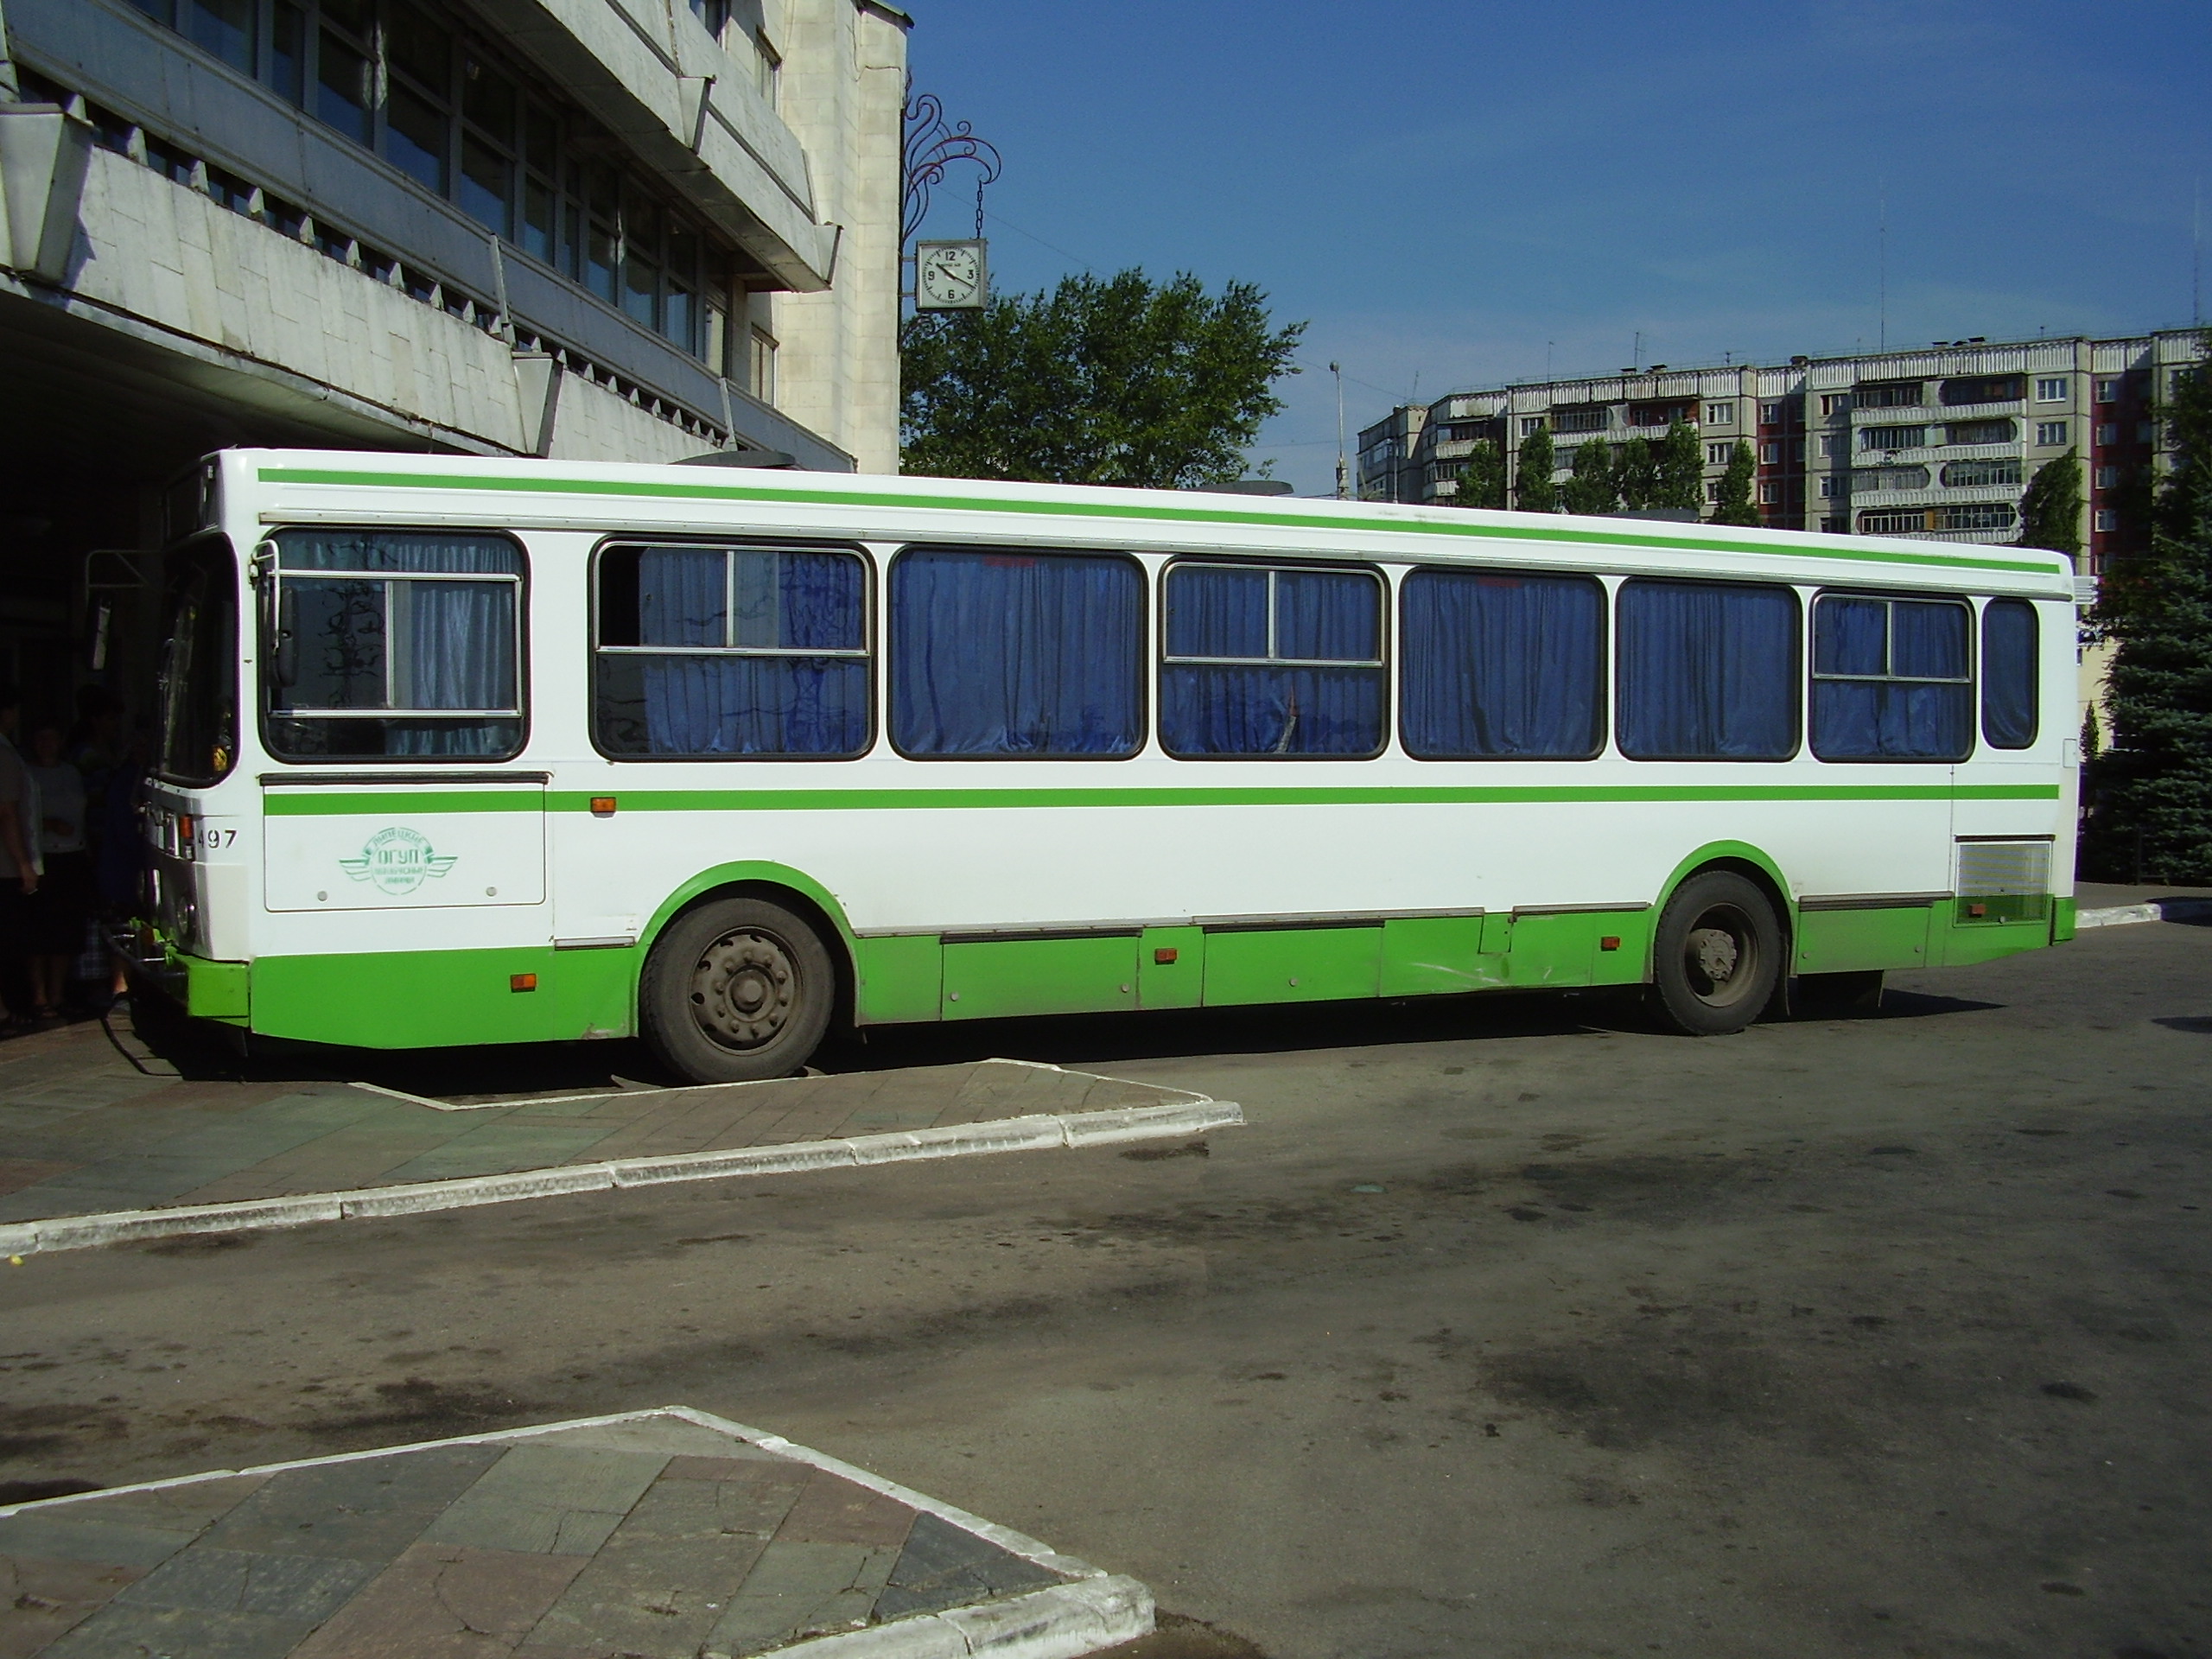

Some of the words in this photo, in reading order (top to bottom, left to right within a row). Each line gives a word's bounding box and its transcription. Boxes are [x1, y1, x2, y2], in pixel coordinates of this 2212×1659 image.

[945, 251, 956, 261] 12
[928, 271, 935, 281] 9
[967, 270, 974, 279] 3
[948, 289, 955, 299] 6
[378, 849, 418, 864] ОГУП
